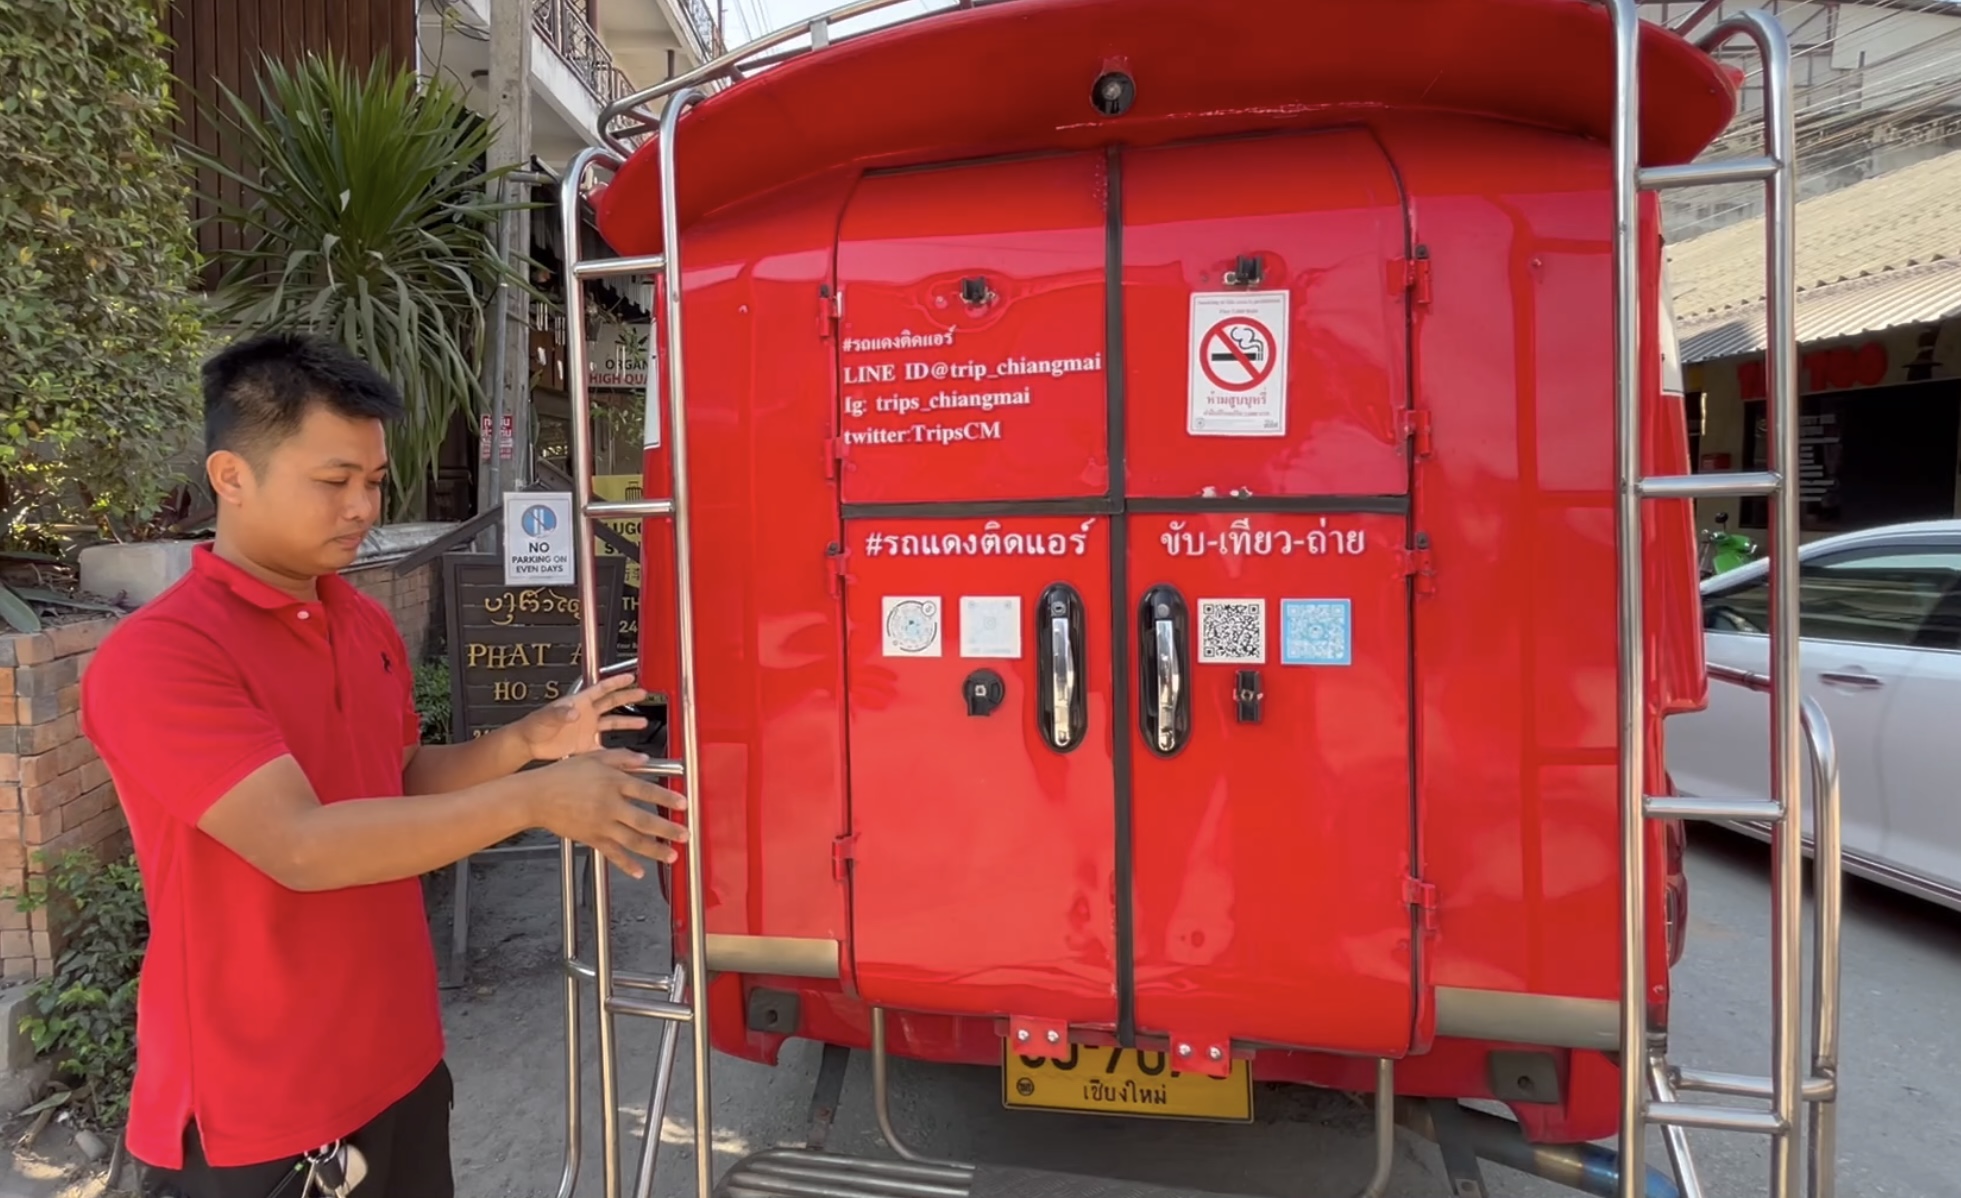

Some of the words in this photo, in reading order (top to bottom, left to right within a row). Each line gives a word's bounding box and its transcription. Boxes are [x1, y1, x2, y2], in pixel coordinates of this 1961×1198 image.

[589, 373, 621, 384] HIGH
[843, 364, 896, 384] LINE
[904, 352, 1102, 382] ID@trip_chiangmai
[876, 387, 1031, 416] trips_chiangmai
[528, 541, 550, 553] NO
[865, 518, 1094, 556] #รถแดงติดแอร์
[511, 555, 551, 564] PARKING
[553, 555, 568, 563] ON
[516, 565, 539, 574] EVEN
[540, 564, 564, 573] DAYS
[467, 643, 552, 669] PHAT
[1083, 1078, 1168, 1105] เชียงใหม่
